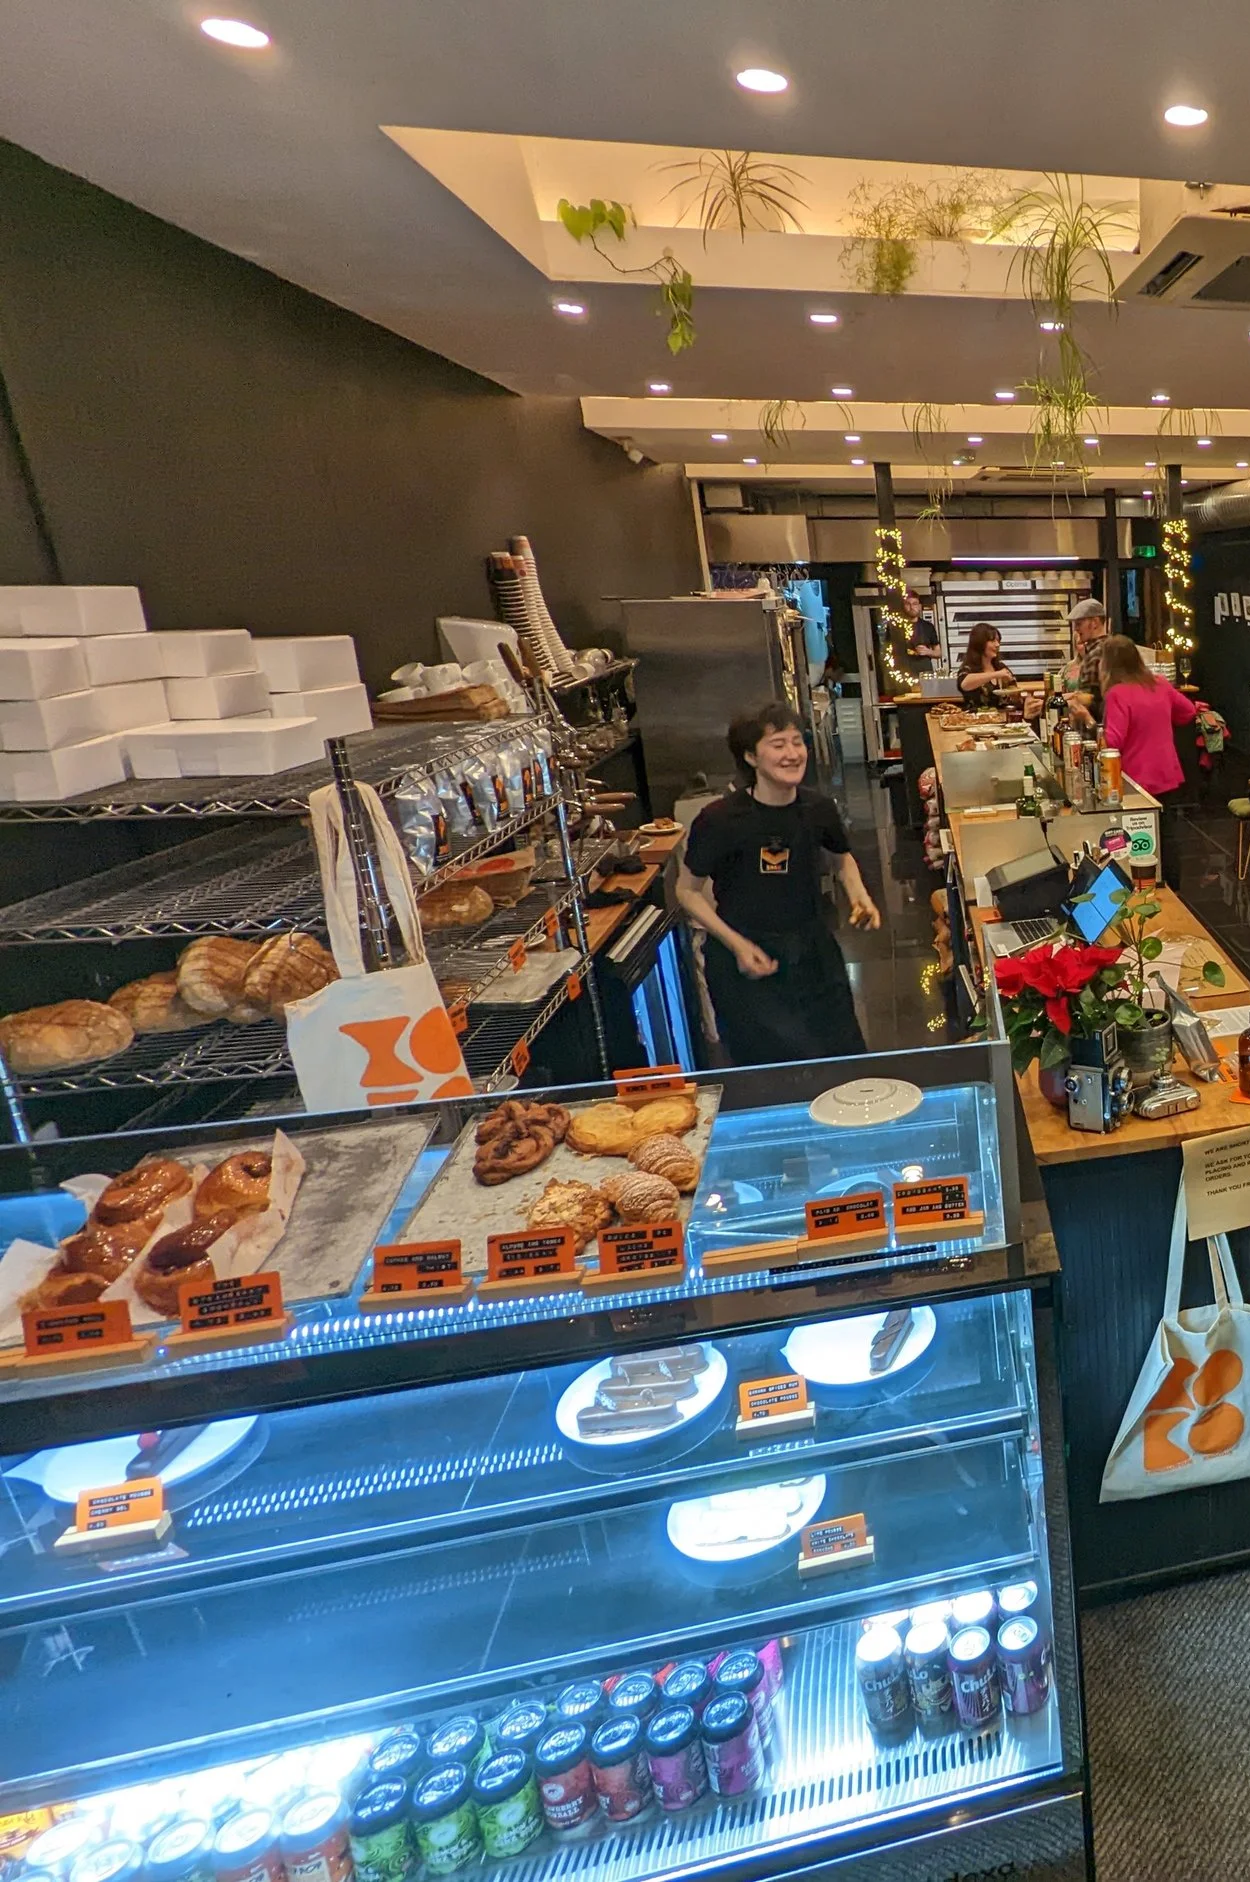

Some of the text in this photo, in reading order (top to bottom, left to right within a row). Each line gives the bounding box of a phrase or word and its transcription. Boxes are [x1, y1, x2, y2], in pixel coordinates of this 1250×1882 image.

[1204, 1148, 1214, 1156] WE
[1215, 1144, 1228, 1153] ARE
[1229, 1140, 1250, 1149] SHORT
[1204, 1161, 1214, 1169] WE
[1215, 1158, 1228, 1166] ASK
[1229, 1155, 1243, 1163] FOR
[1204, 1165, 1232, 1175] PLACING
[1232, 1161, 1246, 1169] AND
[1206, 1187, 1228, 1197] THANK
[1228, 1183, 1242, 1192] YOU
